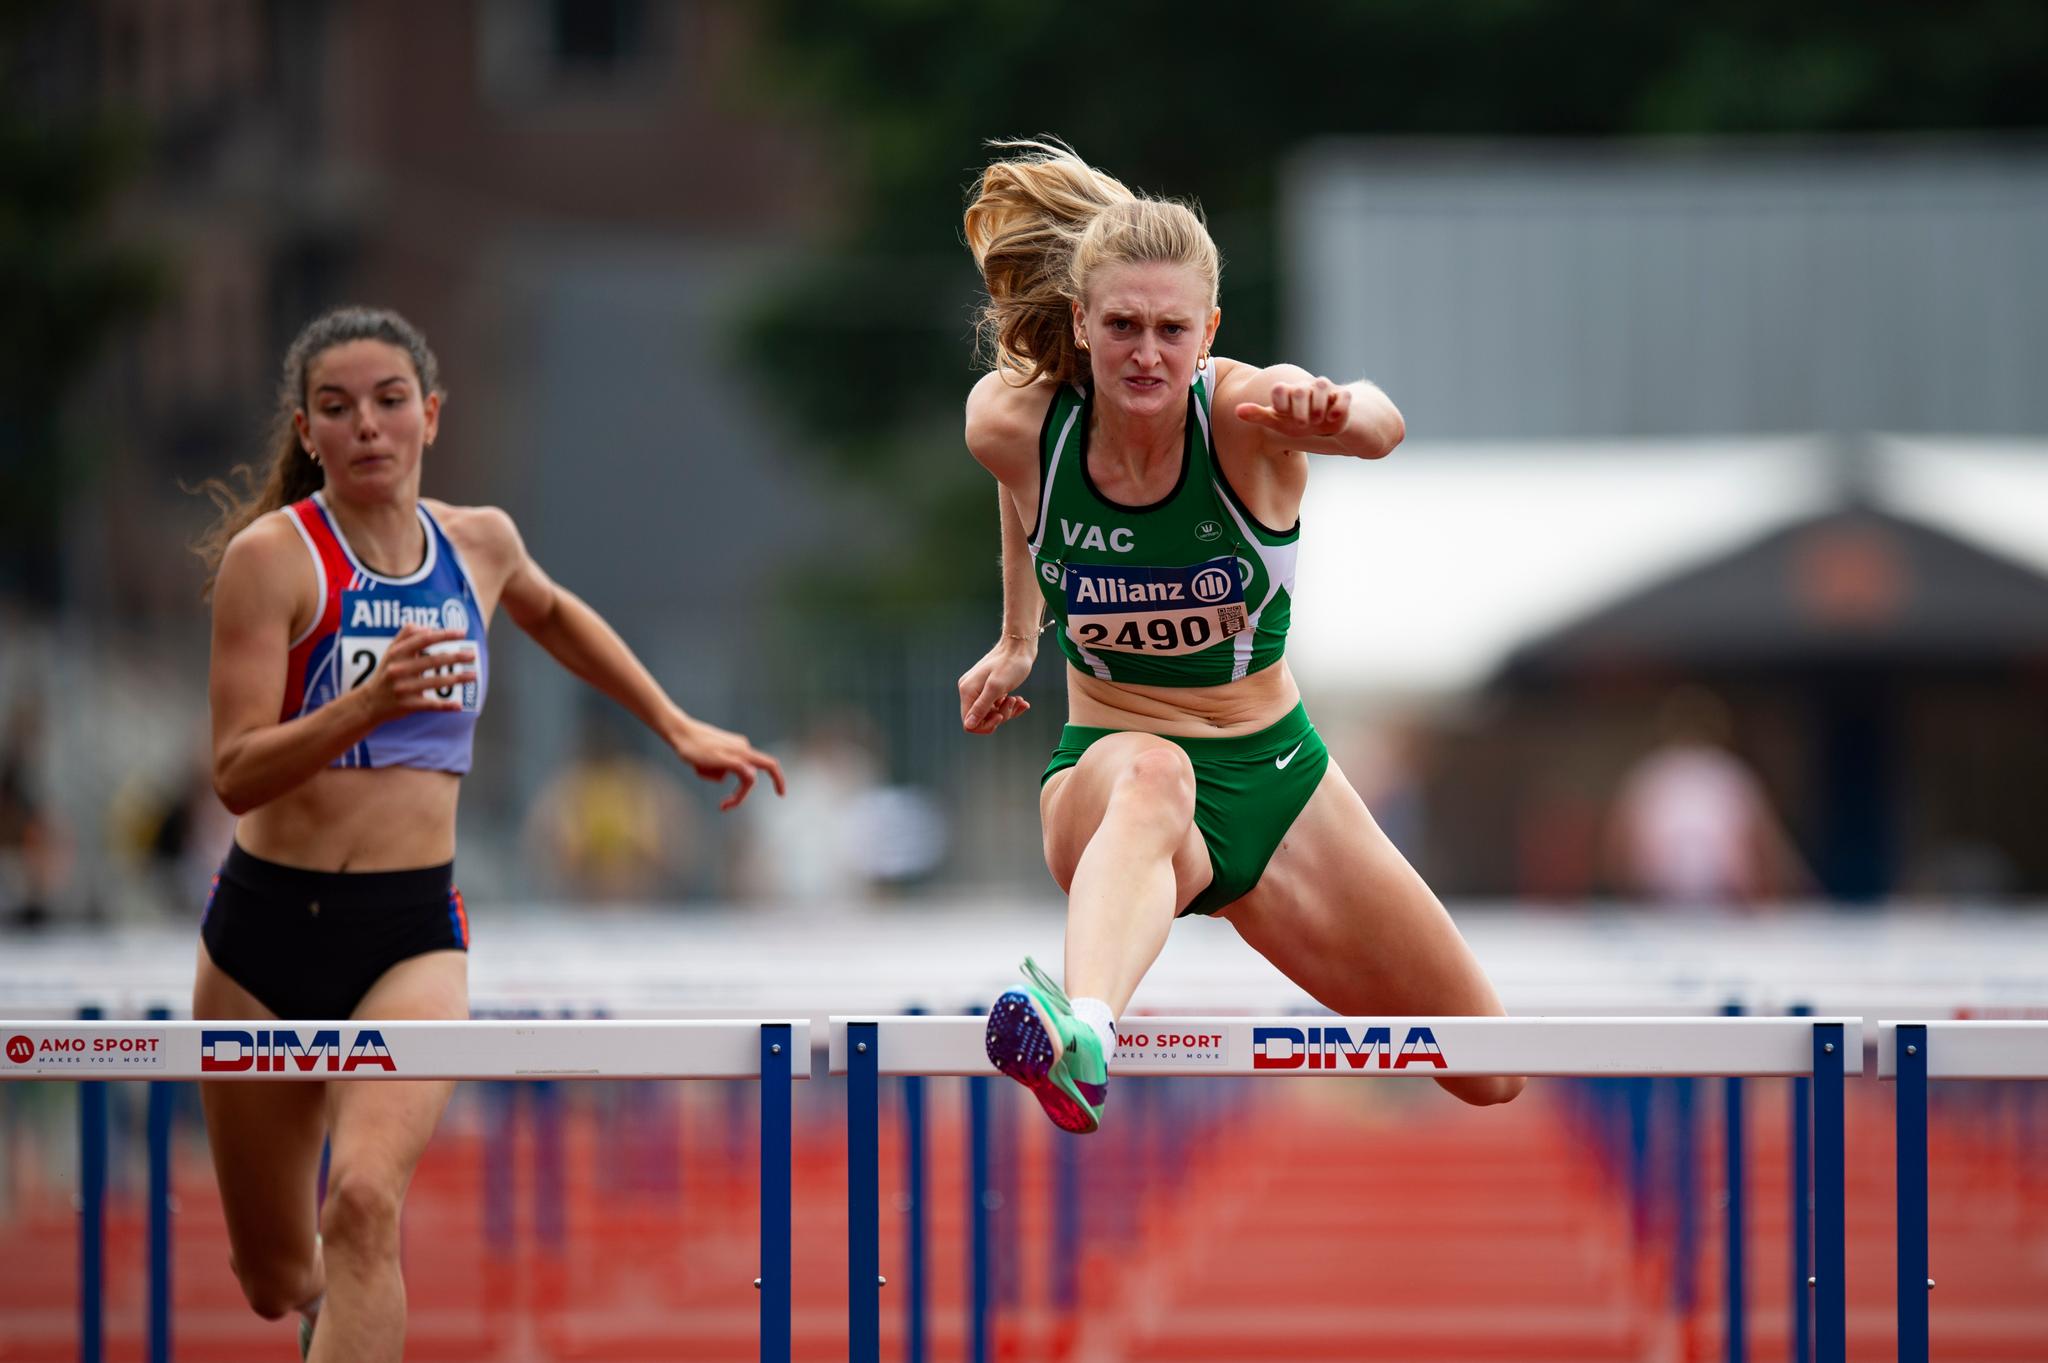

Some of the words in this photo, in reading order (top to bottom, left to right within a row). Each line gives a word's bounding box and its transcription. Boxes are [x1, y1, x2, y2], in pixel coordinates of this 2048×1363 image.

[1061, 519, 1135, 552] VAC
[1076, 576, 1185, 603] Allianz
[352, 600, 439, 629] Allianz
[1079, 616, 1211, 650] 2490
[39, 1039, 86, 1052] AMO
[93, 1039, 159, 1052] SPORT
[201, 1030, 397, 1072] DIMA
[1118, 1034, 1149, 1047] MO
[1156, 1034, 1222, 1047] SPORT
[1253, 1027, 1447, 1069] DIMA
